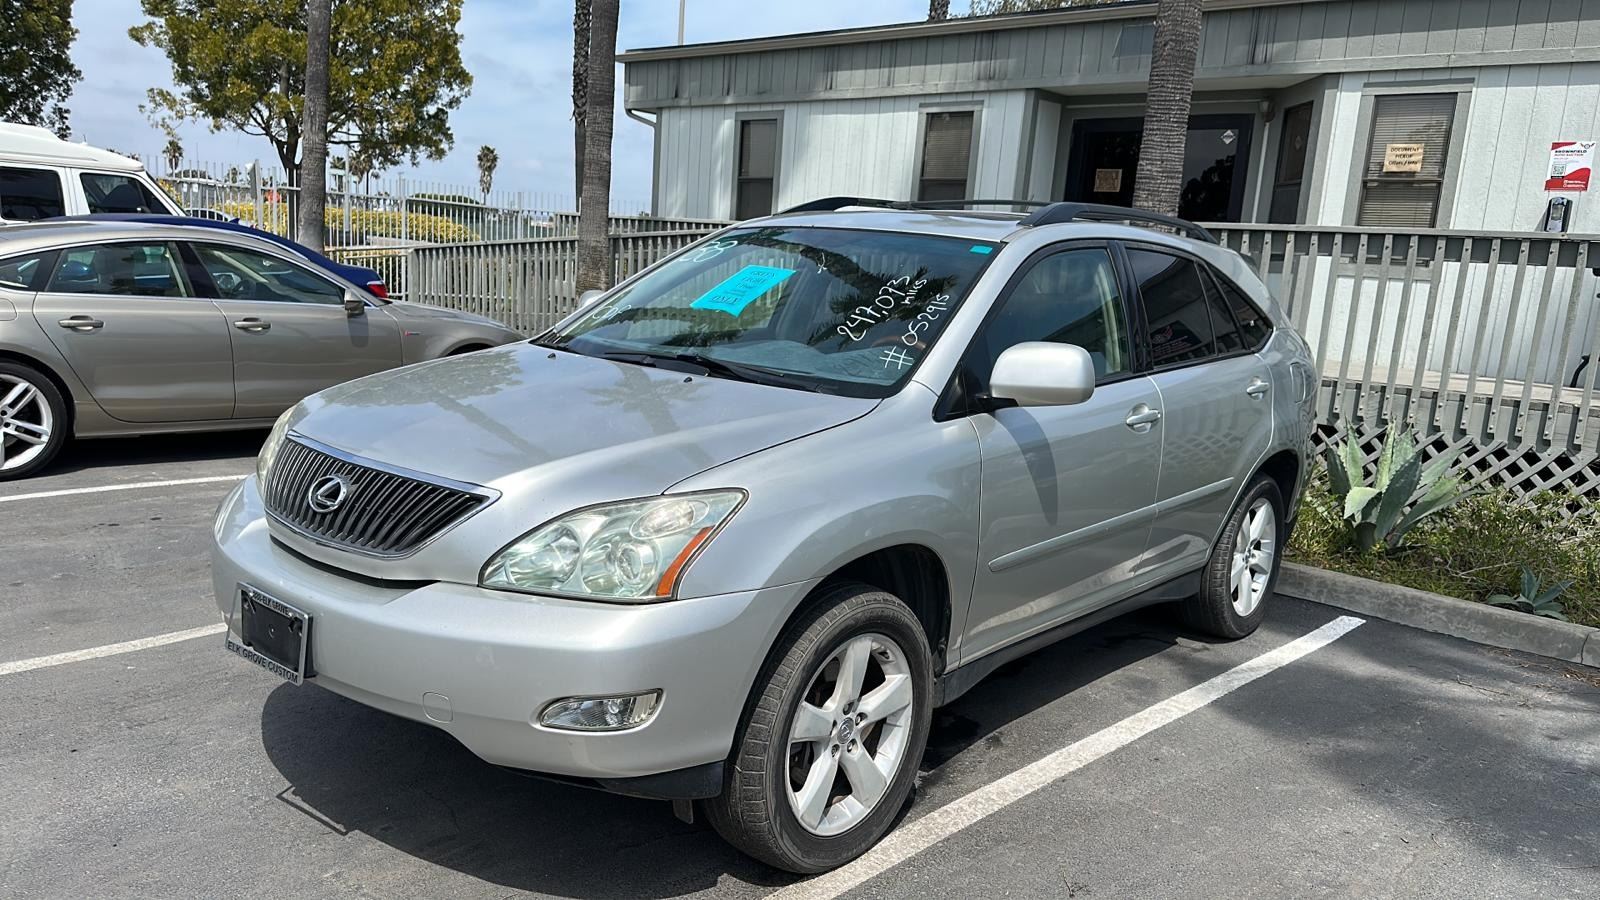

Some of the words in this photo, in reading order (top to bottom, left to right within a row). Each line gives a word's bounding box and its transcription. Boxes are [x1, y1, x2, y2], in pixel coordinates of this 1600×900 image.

[836, 274, 911, 342] 247,073
[227, 641, 241, 655] ELK
[242, 648, 267, 668] GROVE
[267, 661, 298, 684] CUSTOM
